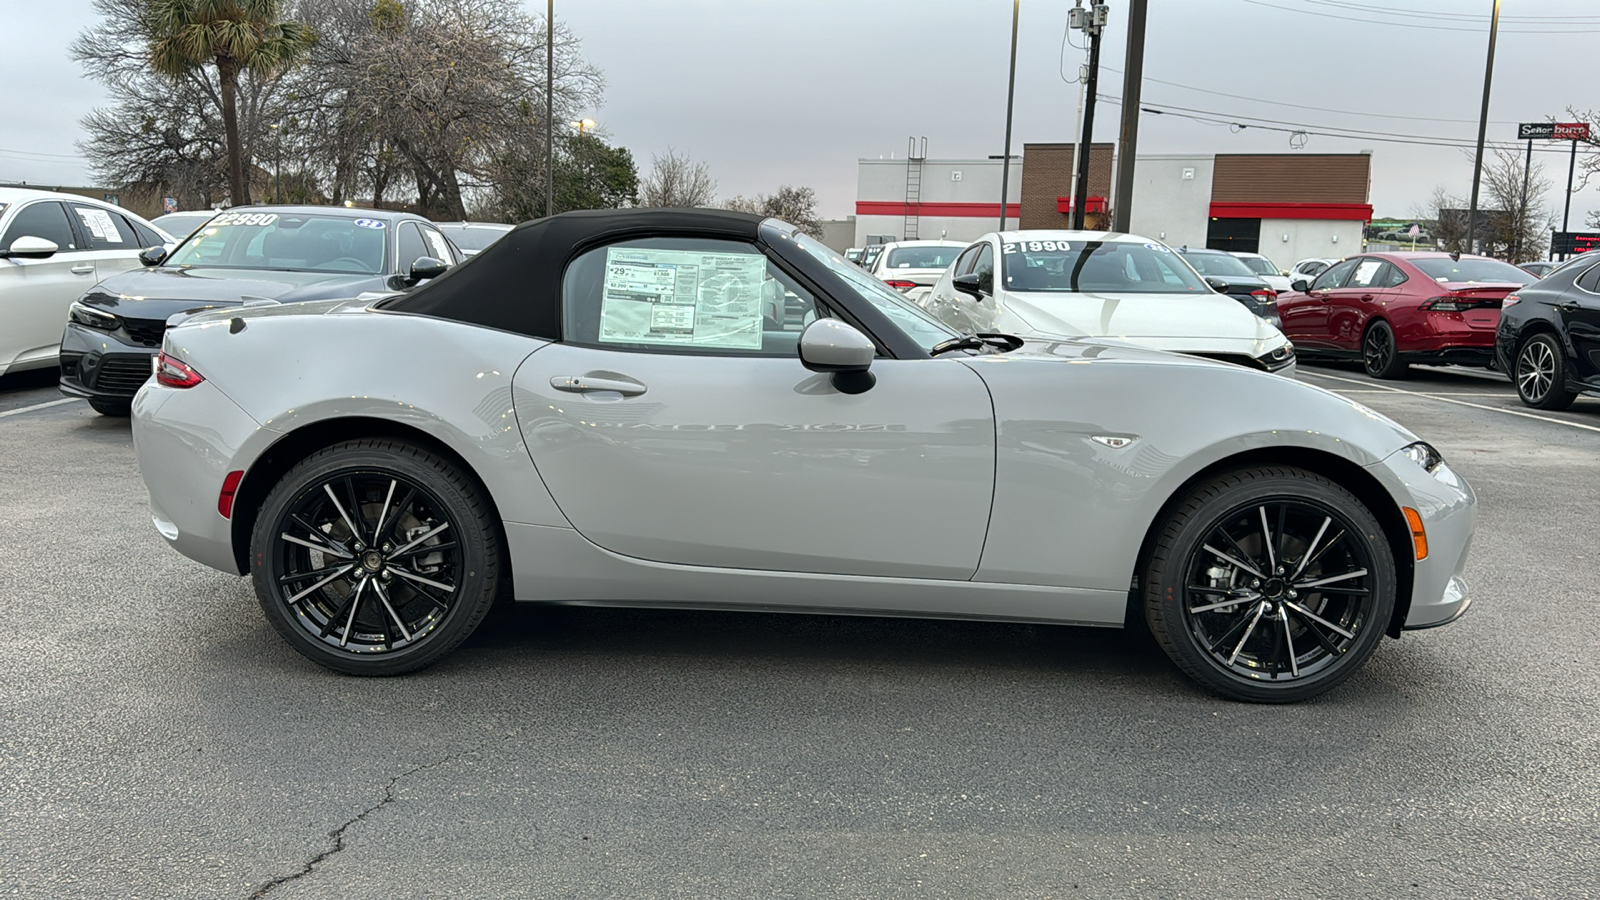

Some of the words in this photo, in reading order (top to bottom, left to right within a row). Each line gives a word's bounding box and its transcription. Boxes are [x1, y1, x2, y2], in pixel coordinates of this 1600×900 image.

[206, 213, 279, 226] 22990
[1002, 241, 1071, 255] 21990
[614, 267, 625, 275] 29
